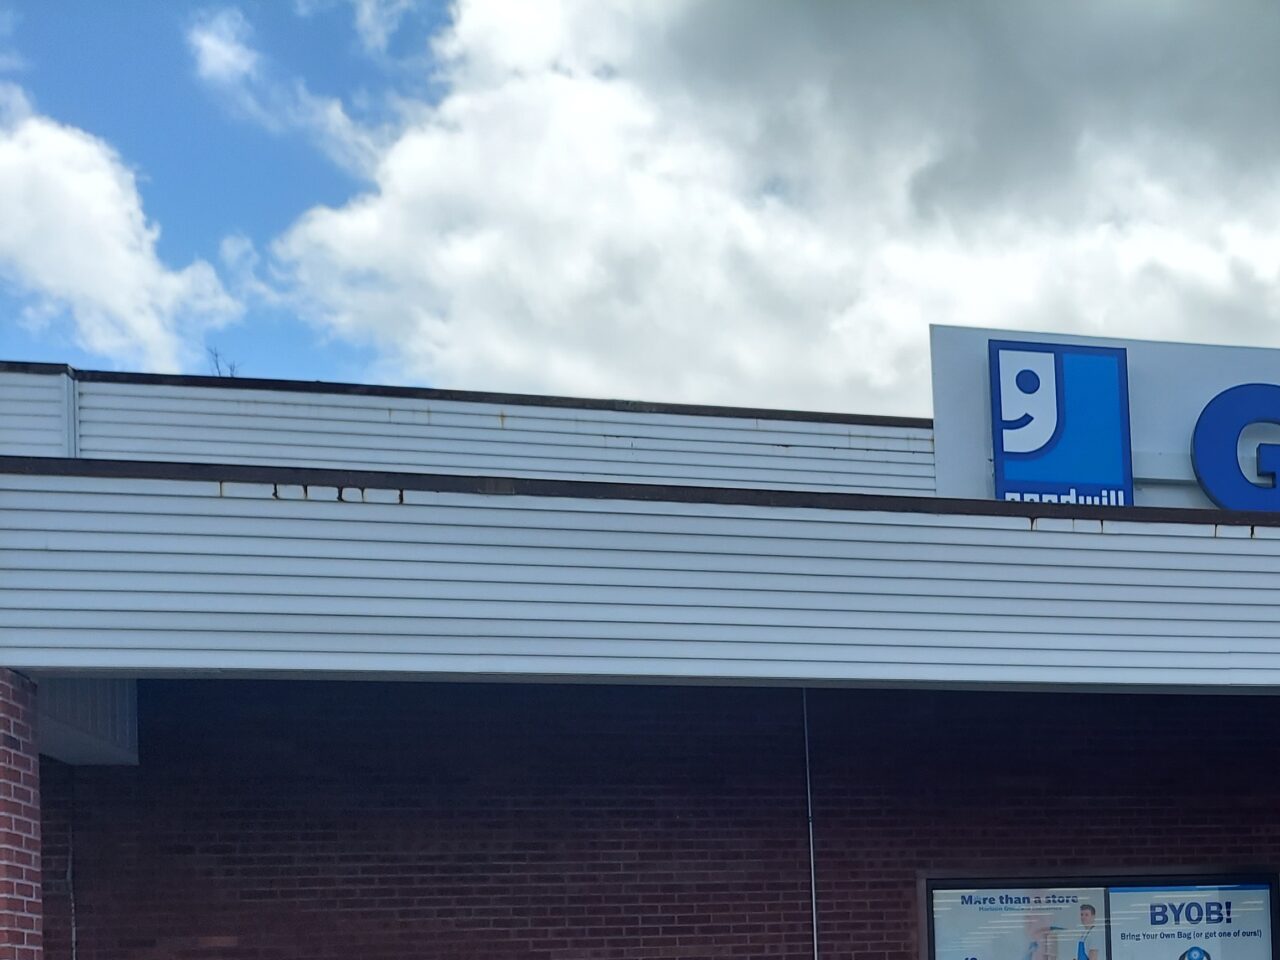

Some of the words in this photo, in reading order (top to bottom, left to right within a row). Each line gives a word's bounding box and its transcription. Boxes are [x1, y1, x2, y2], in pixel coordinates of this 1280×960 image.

[960, 895, 996, 905] More
[999, 895, 1031, 905] than
[1033, 896, 1042, 904] a
[1045, 895, 1078, 904] store
[1150, 901, 1232, 925] BYOB!
[1121, 932, 1141, 941] Bring
[1177, 932, 1191, 940] Bag
[1193, 931, 1202, 939] (or
[1205, 931, 1216, 939] get
